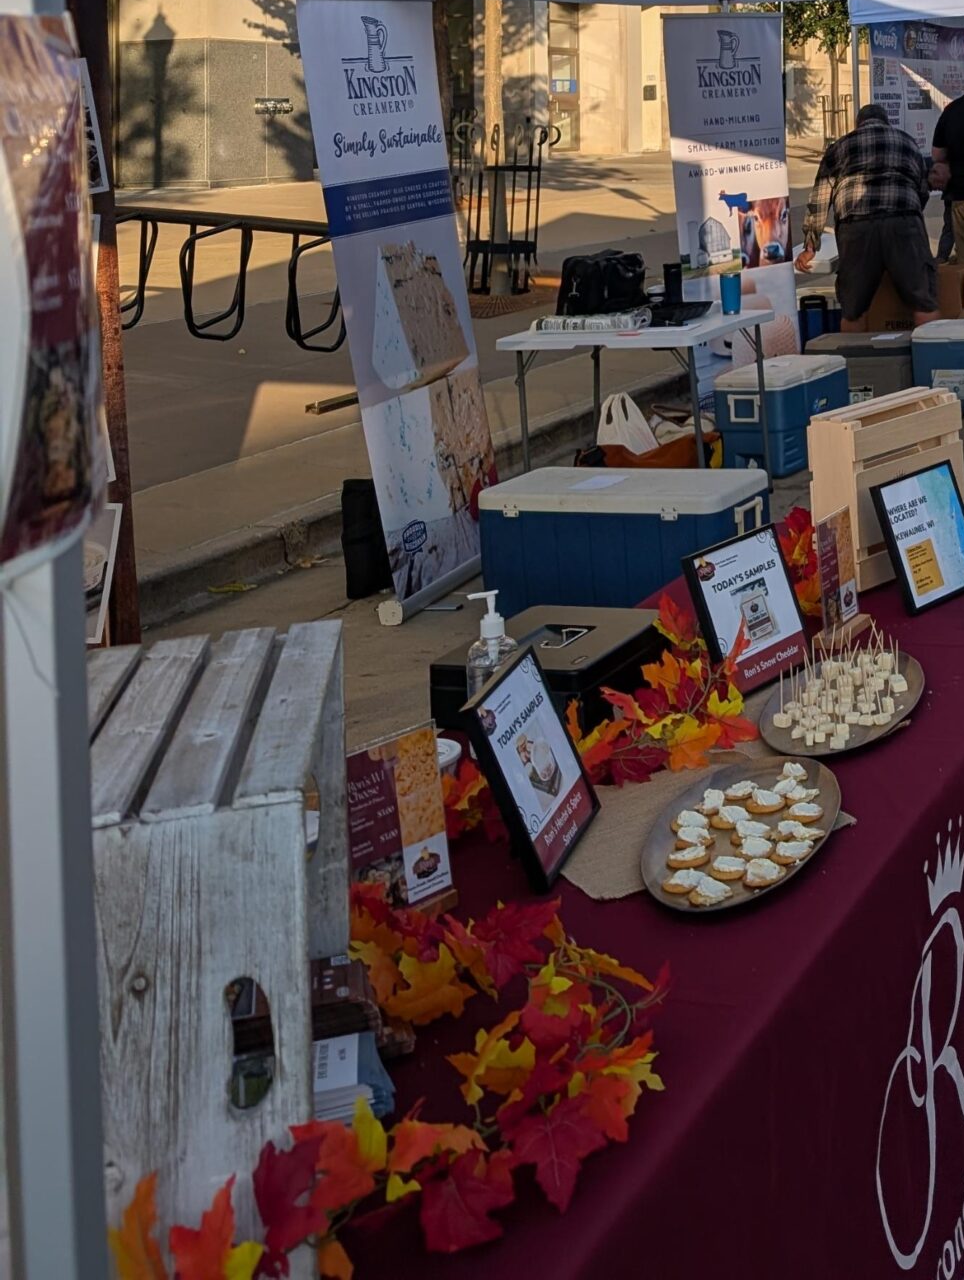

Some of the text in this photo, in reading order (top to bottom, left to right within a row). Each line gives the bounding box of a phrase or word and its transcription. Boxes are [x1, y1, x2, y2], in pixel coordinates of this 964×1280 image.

[343, 66, 417, 100] KINGSTON
[697, 64, 762, 88] KINGSTON
[703, 114, 760, 126] HAND-MILKING
[333, 124, 442, 158] Simply Sustainable
[688, 137, 780, 153] SMALL FARM TRADITION
[688, 160, 782, 178] AWARD-WINNING CHEESE
[888, 495, 928, 516] WHERE ARE WE
[890, 508, 918, 525] LOCATED?
[895, 520, 935, 541] KEWAUNEE, WI
[712, 573, 744, 594] TODAY'S
[744, 559, 777, 580] SAMPLES
[744, 645, 799, 678] Ron's Snow Cheddar
[497, 716, 523, 750] TODAY'S
[520, 692, 544, 724] SAMPLES
